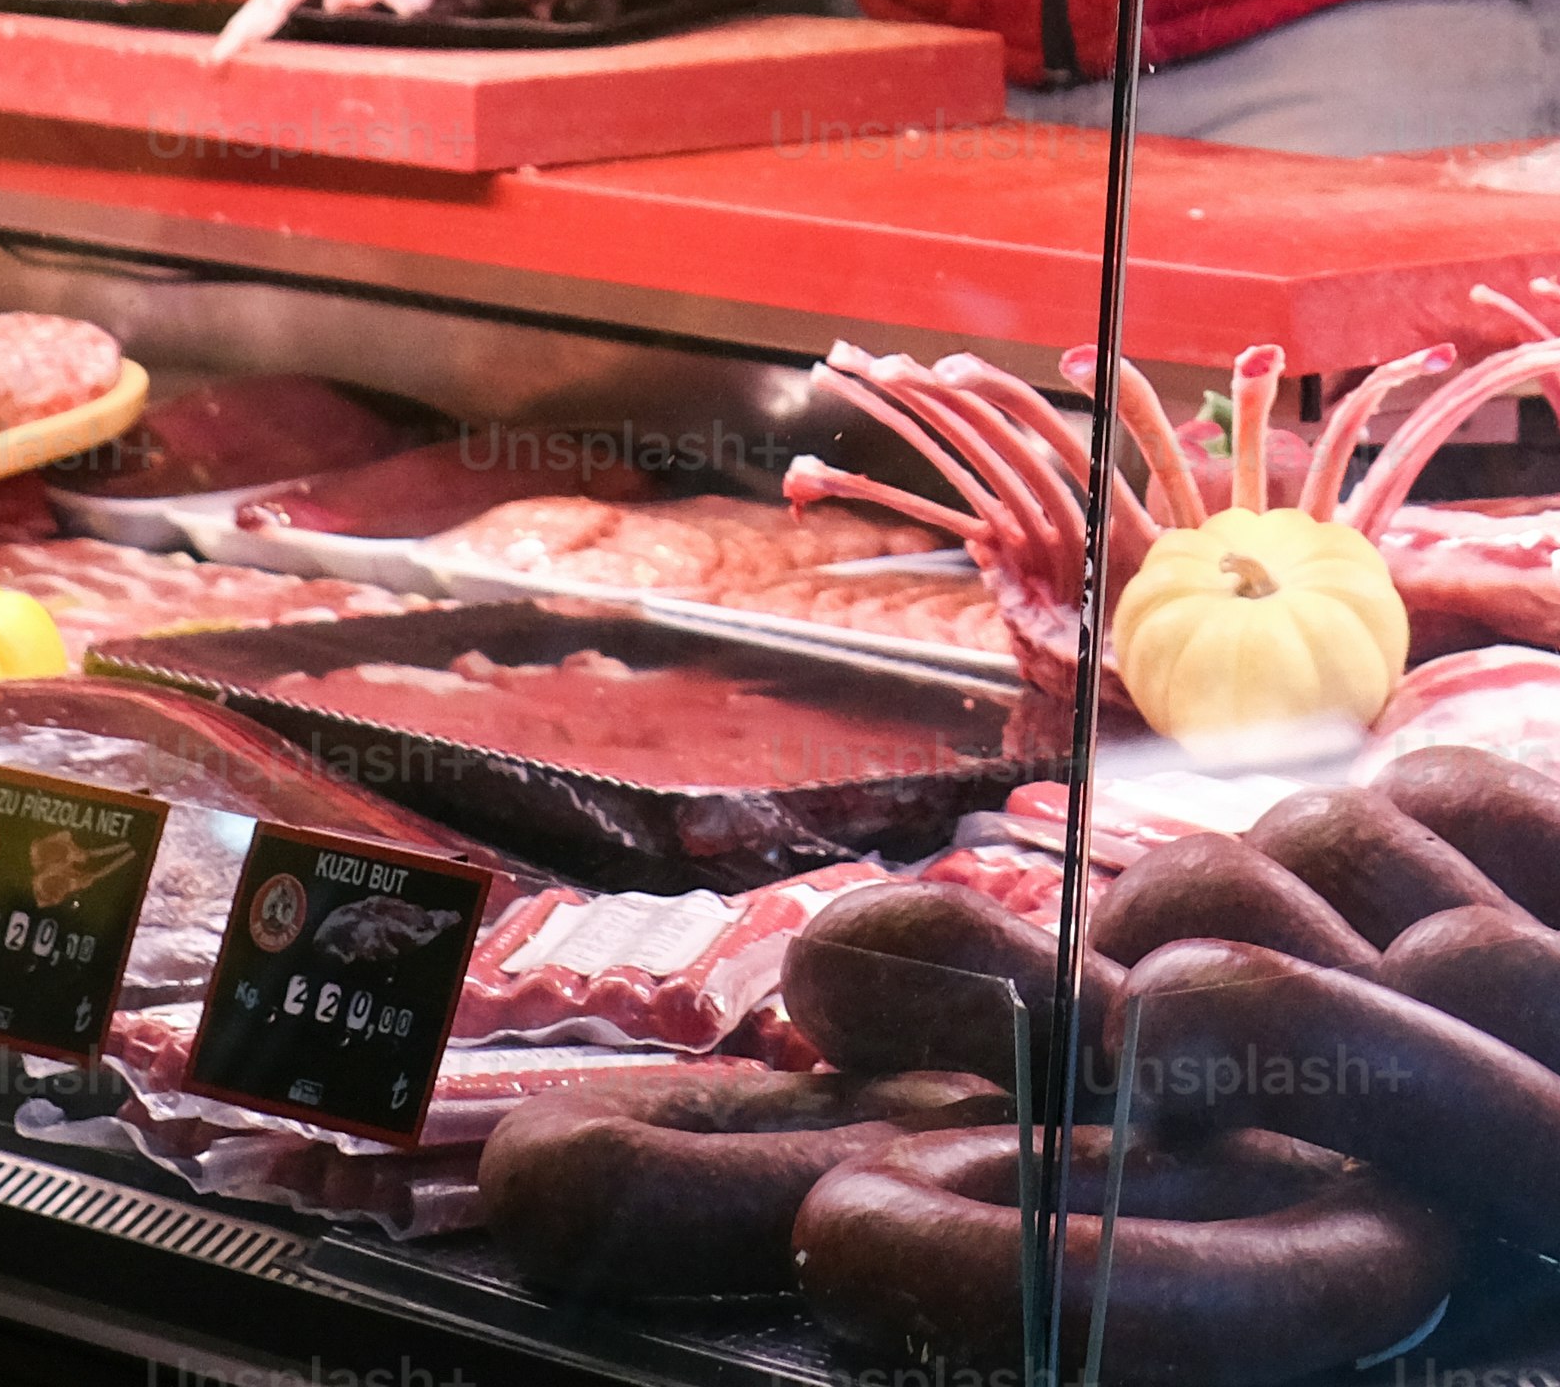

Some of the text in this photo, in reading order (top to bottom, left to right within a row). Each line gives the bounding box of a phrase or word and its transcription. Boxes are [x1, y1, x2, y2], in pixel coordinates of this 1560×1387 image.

[19, 789, 92, 833] PİRZOLA
[93, 811, 135, 840] NET
[314, 852, 409, 896] KUZU BUT
[283, 975, 413, 1040] 220,00
